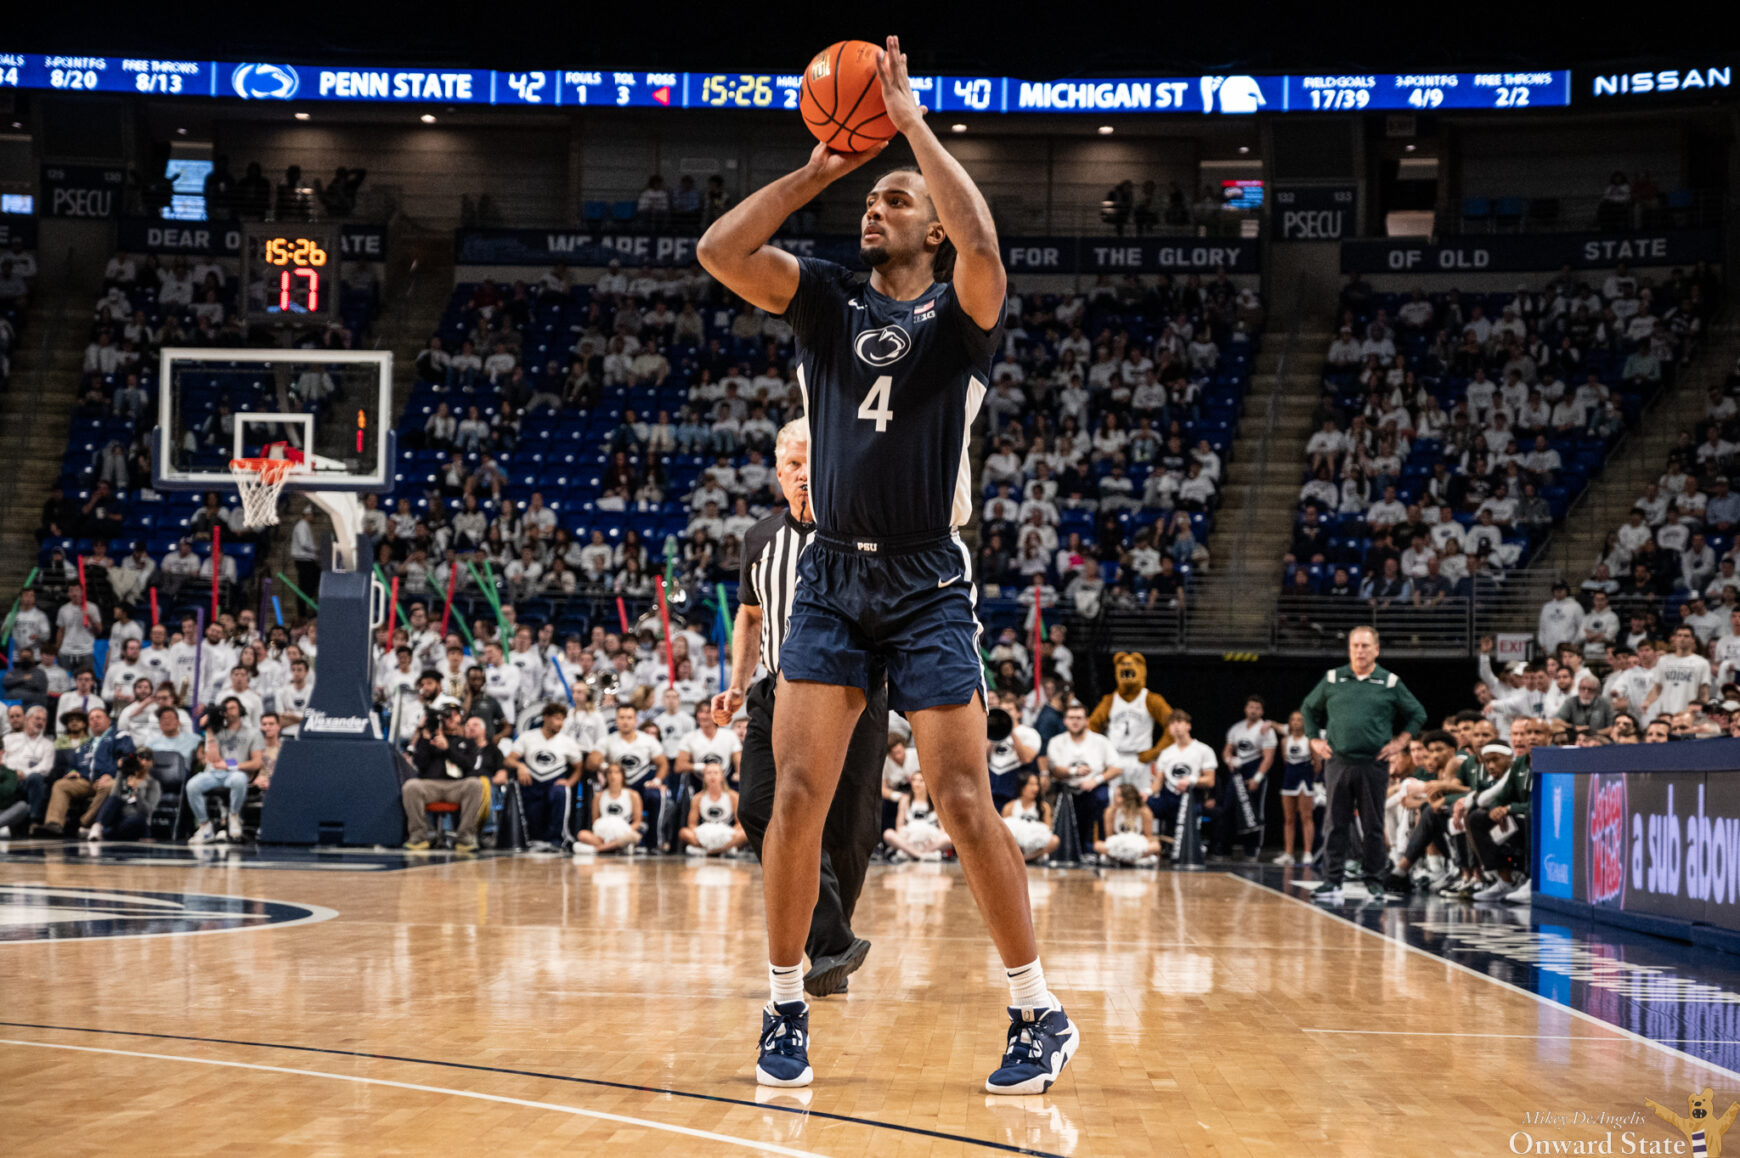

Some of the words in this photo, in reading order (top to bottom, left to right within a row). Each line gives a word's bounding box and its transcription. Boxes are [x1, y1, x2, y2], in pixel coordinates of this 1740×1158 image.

[50, 69, 98, 89] 8/20
[136, 73, 183, 93] 8/13
[319, 71, 389, 98] PENN
[393, 73, 472, 99] STATE
[508, 72, 546, 103] 42
[565, 72, 602, 85] FOULS
[1474, 74, 1503, 86] FREE
[1593, 66, 1731, 97] NISSAN
[576, 85, 587, 105] 1
[616, 86, 630, 105] 3
[702, 75, 773, 106] 15:26
[784, 89, 798, 108] 2
[954, 79, 991, 109] 40
[1018, 82, 1151, 109] MICHIGAN
[1155, 82, 1189, 108] ST
[1310, 89, 1370, 109] 17/39
[1408, 88, 1444, 108] 4/9
[1495, 87, 1530, 107] 2/2
[53, 188, 111, 216] PSECU
[1283, 210, 1342, 239] PSECU
[147, 228, 210, 248] DEAR
[265, 238, 327, 266] 15:26
[1009, 247, 1059, 267] FOR
[1093, 247, 1143, 267] THE
[1158, 247, 1241, 267] GLORY
[1388, 250, 1422, 269] OF
[1439, 249, 1490, 268] OLD
[1584, 238, 1668, 260] STATE
[279, 268, 319, 313] 17
[857, 375, 894, 432] 4
[857, 542, 878, 552] PSU
[1500, 639, 1527, 654] EXI
[1632, 811, 1644, 890] a
[1648, 783, 1681, 896] sub
[1686, 783, 1740, 905] abov
